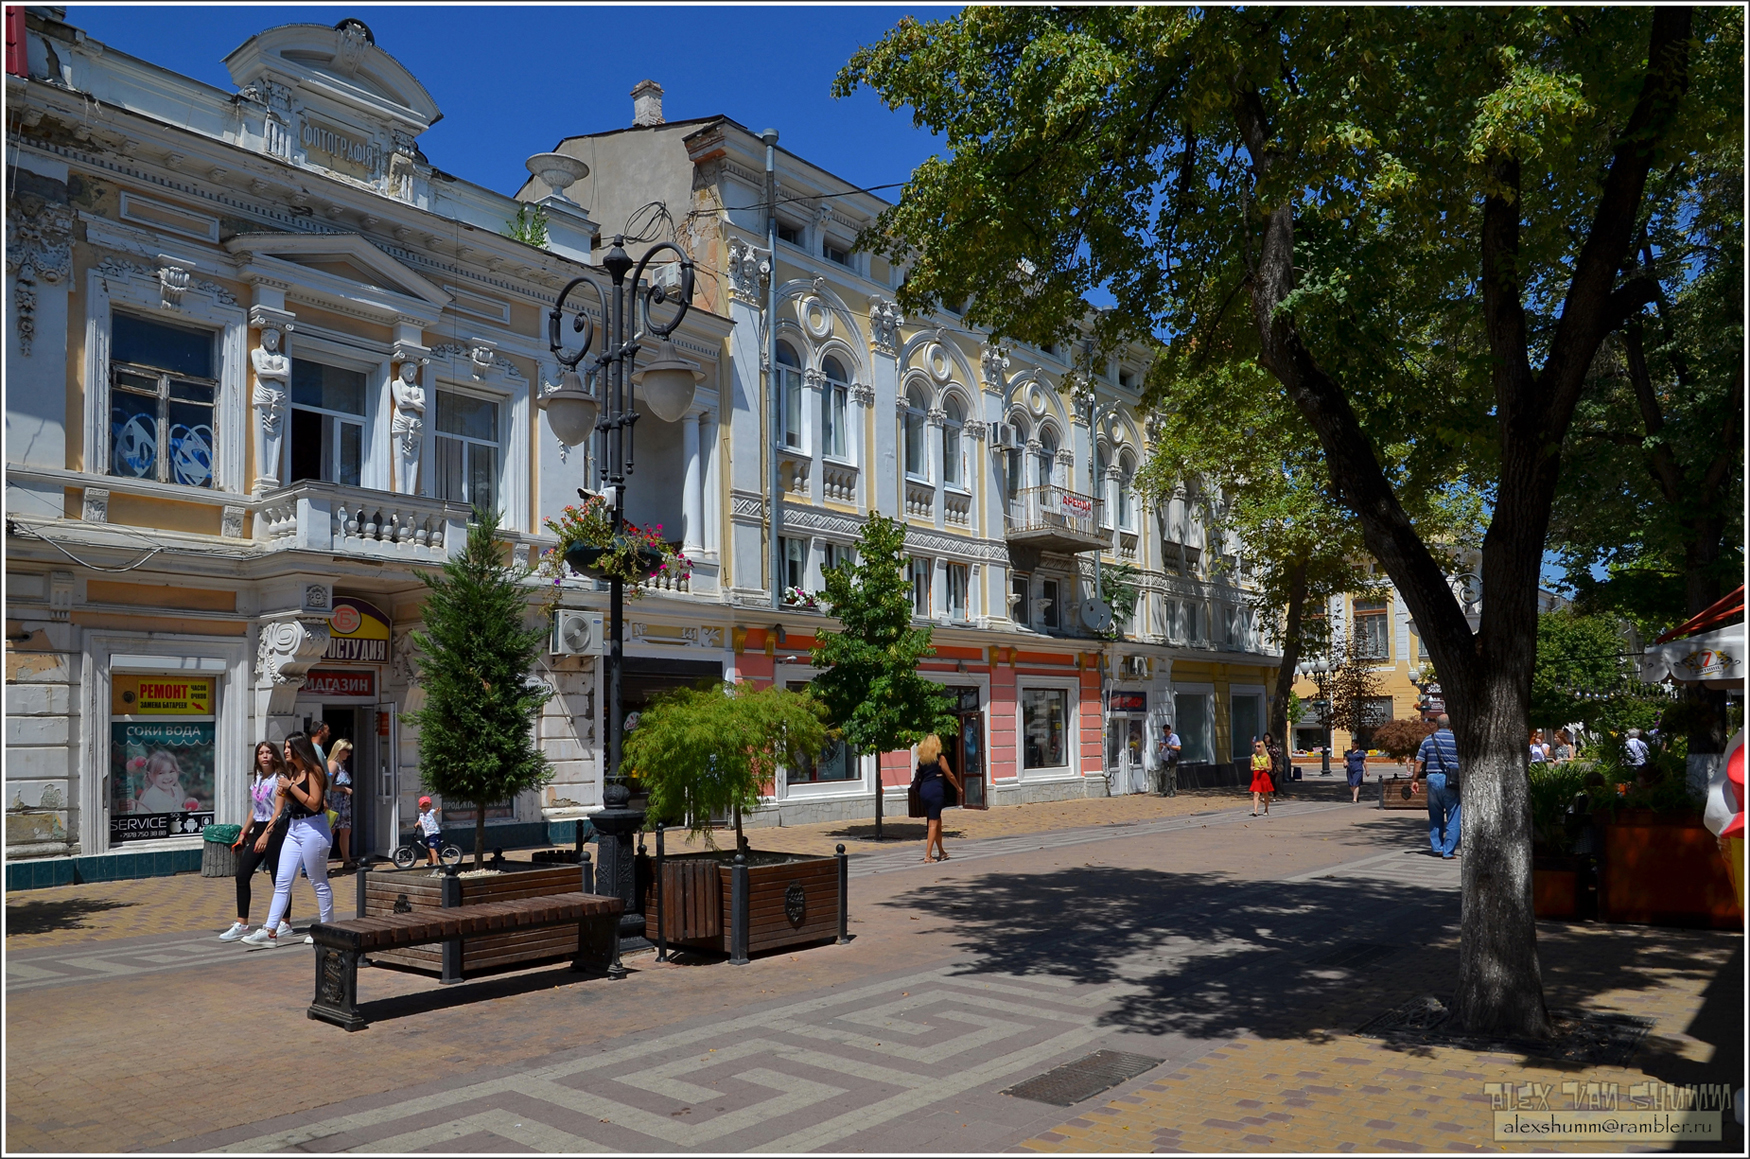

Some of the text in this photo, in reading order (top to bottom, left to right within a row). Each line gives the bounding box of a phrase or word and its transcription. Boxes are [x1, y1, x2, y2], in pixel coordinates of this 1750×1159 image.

[1062, 495, 1092, 512] АРЕНДА
[681, 626, 698, 639] 141
[322, 638, 386, 660] ОСТУДИЯ
[140, 684, 188, 699] РЕМОНТ
[304, 678, 368, 691] МАГАЗИН
[140, 701, 188, 709] ЗАМЕНА БАТАРЕЕК
[126, 726, 201, 737] СОКИ ВОДА
[111, 816, 167, 831] SERVICE
